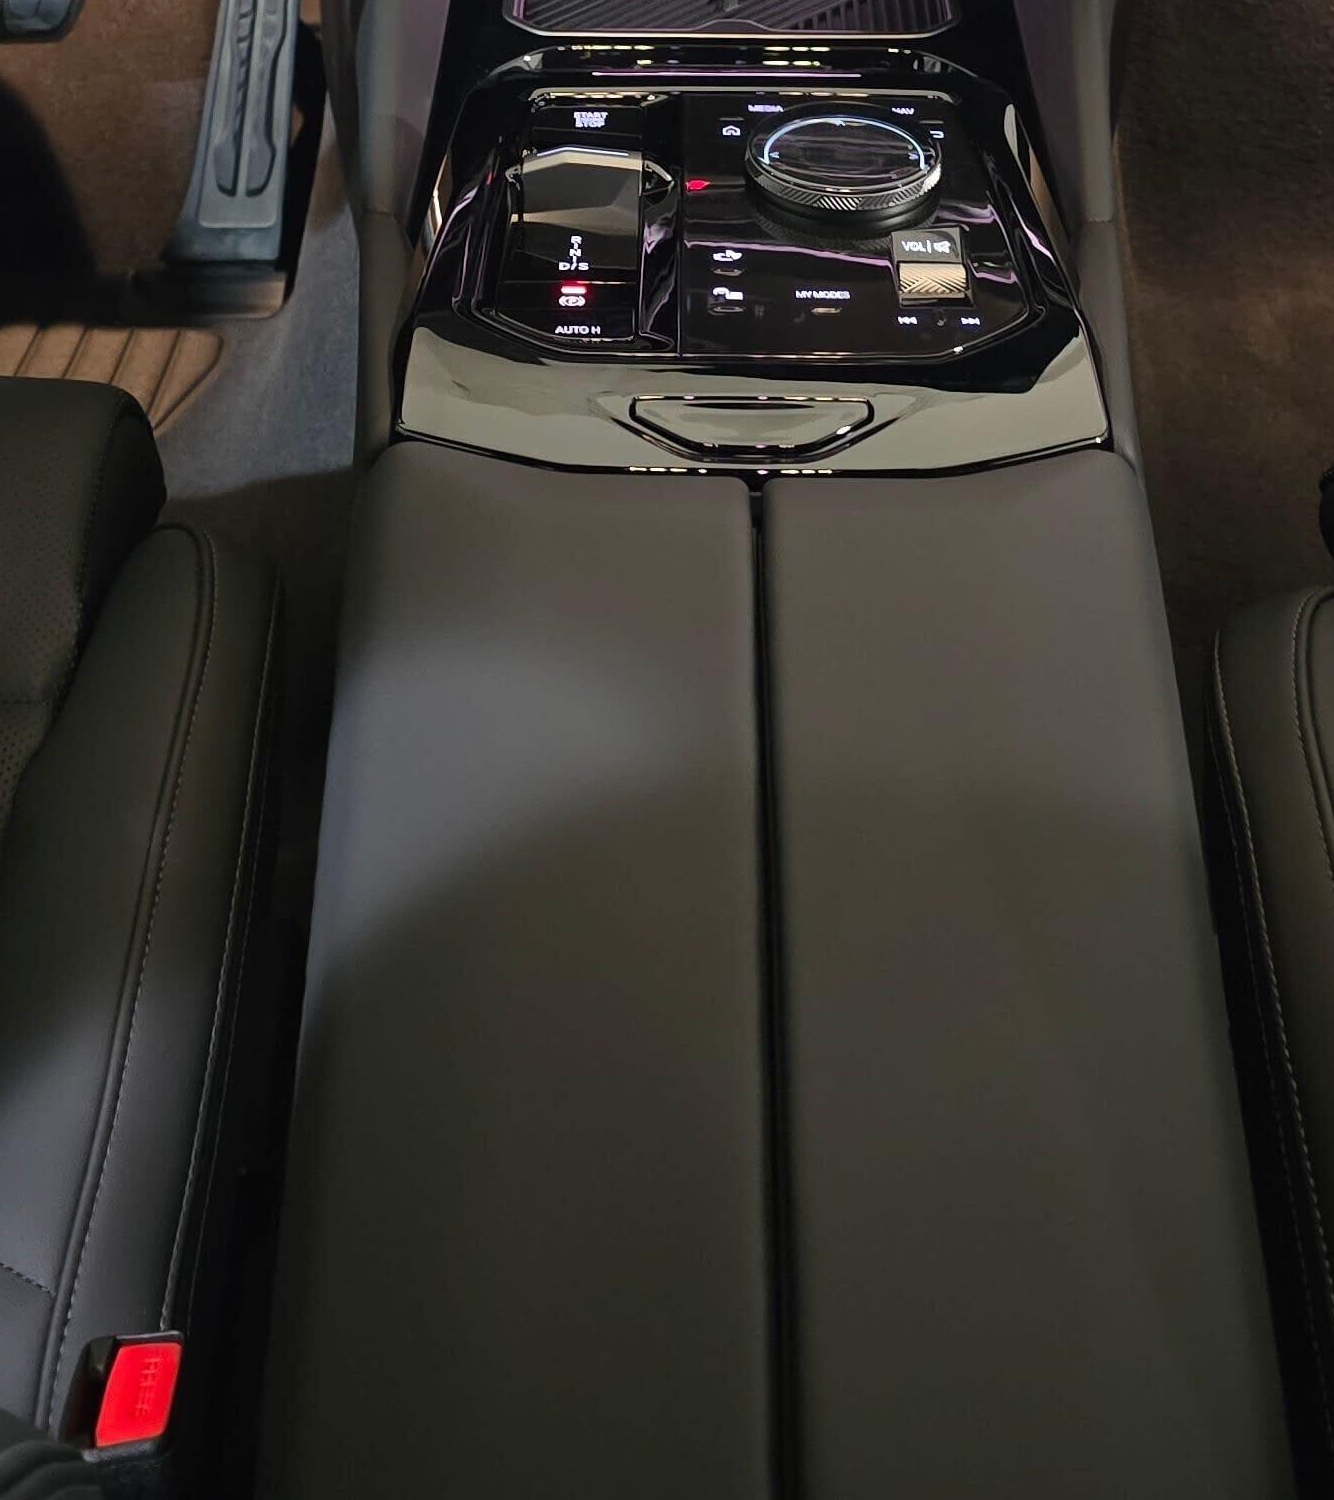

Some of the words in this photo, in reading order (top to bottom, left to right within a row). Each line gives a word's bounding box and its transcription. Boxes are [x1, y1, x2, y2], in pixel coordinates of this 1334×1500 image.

[748, 104, 784, 113] MEDIA
[891, 107, 915, 115] NAV
[573, 111, 609, 119] START
[570, 235, 583, 245] R
[901, 240, 926, 253] VOL
[569, 248, 582, 257] N
[795, 290, 813, 299] MY
[813, 290, 851, 299] MODES
[554, 325, 590, 335] AUTO
[591, 325, 601, 335] H
